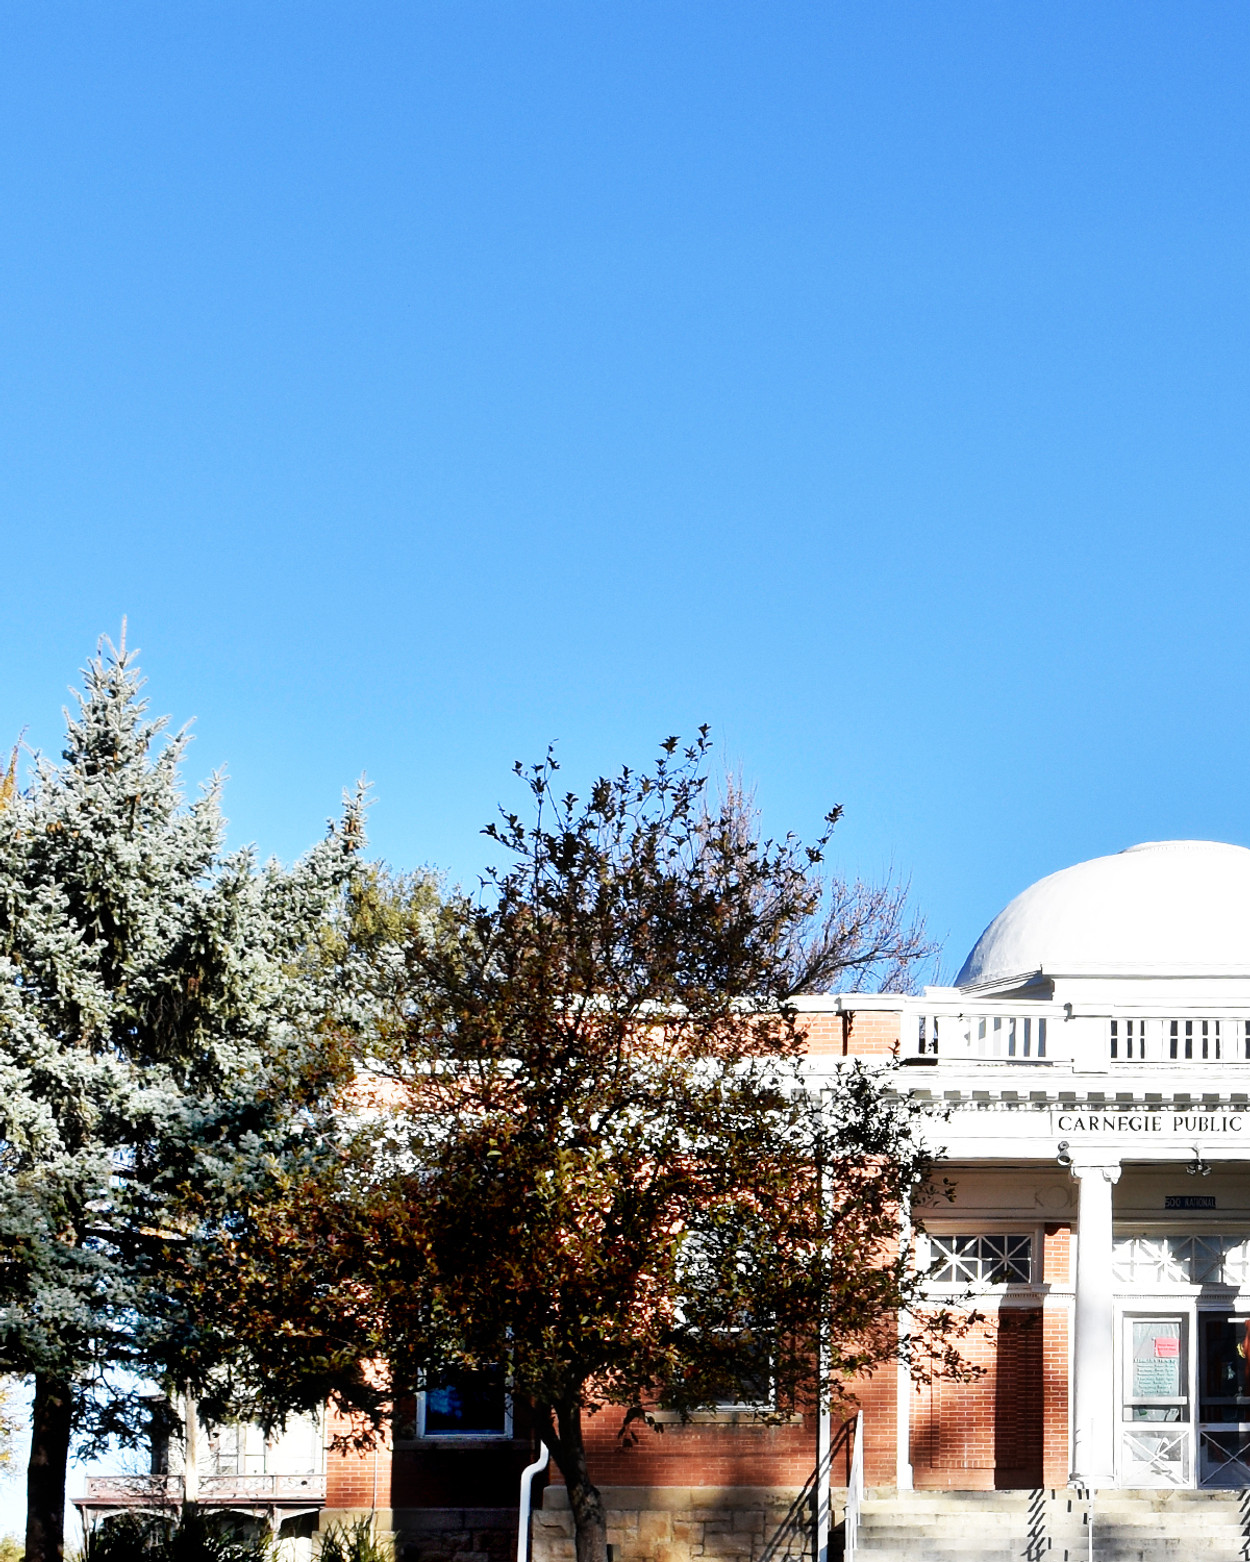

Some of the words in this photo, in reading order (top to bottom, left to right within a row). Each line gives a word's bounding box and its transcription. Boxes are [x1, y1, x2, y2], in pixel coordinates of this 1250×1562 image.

[1058, 1116, 1161, 1131] CARNEGIE
[1173, 1116, 1242, 1132] PUBLIC
[1185, 1197, 1216, 1208] NATIONAL
